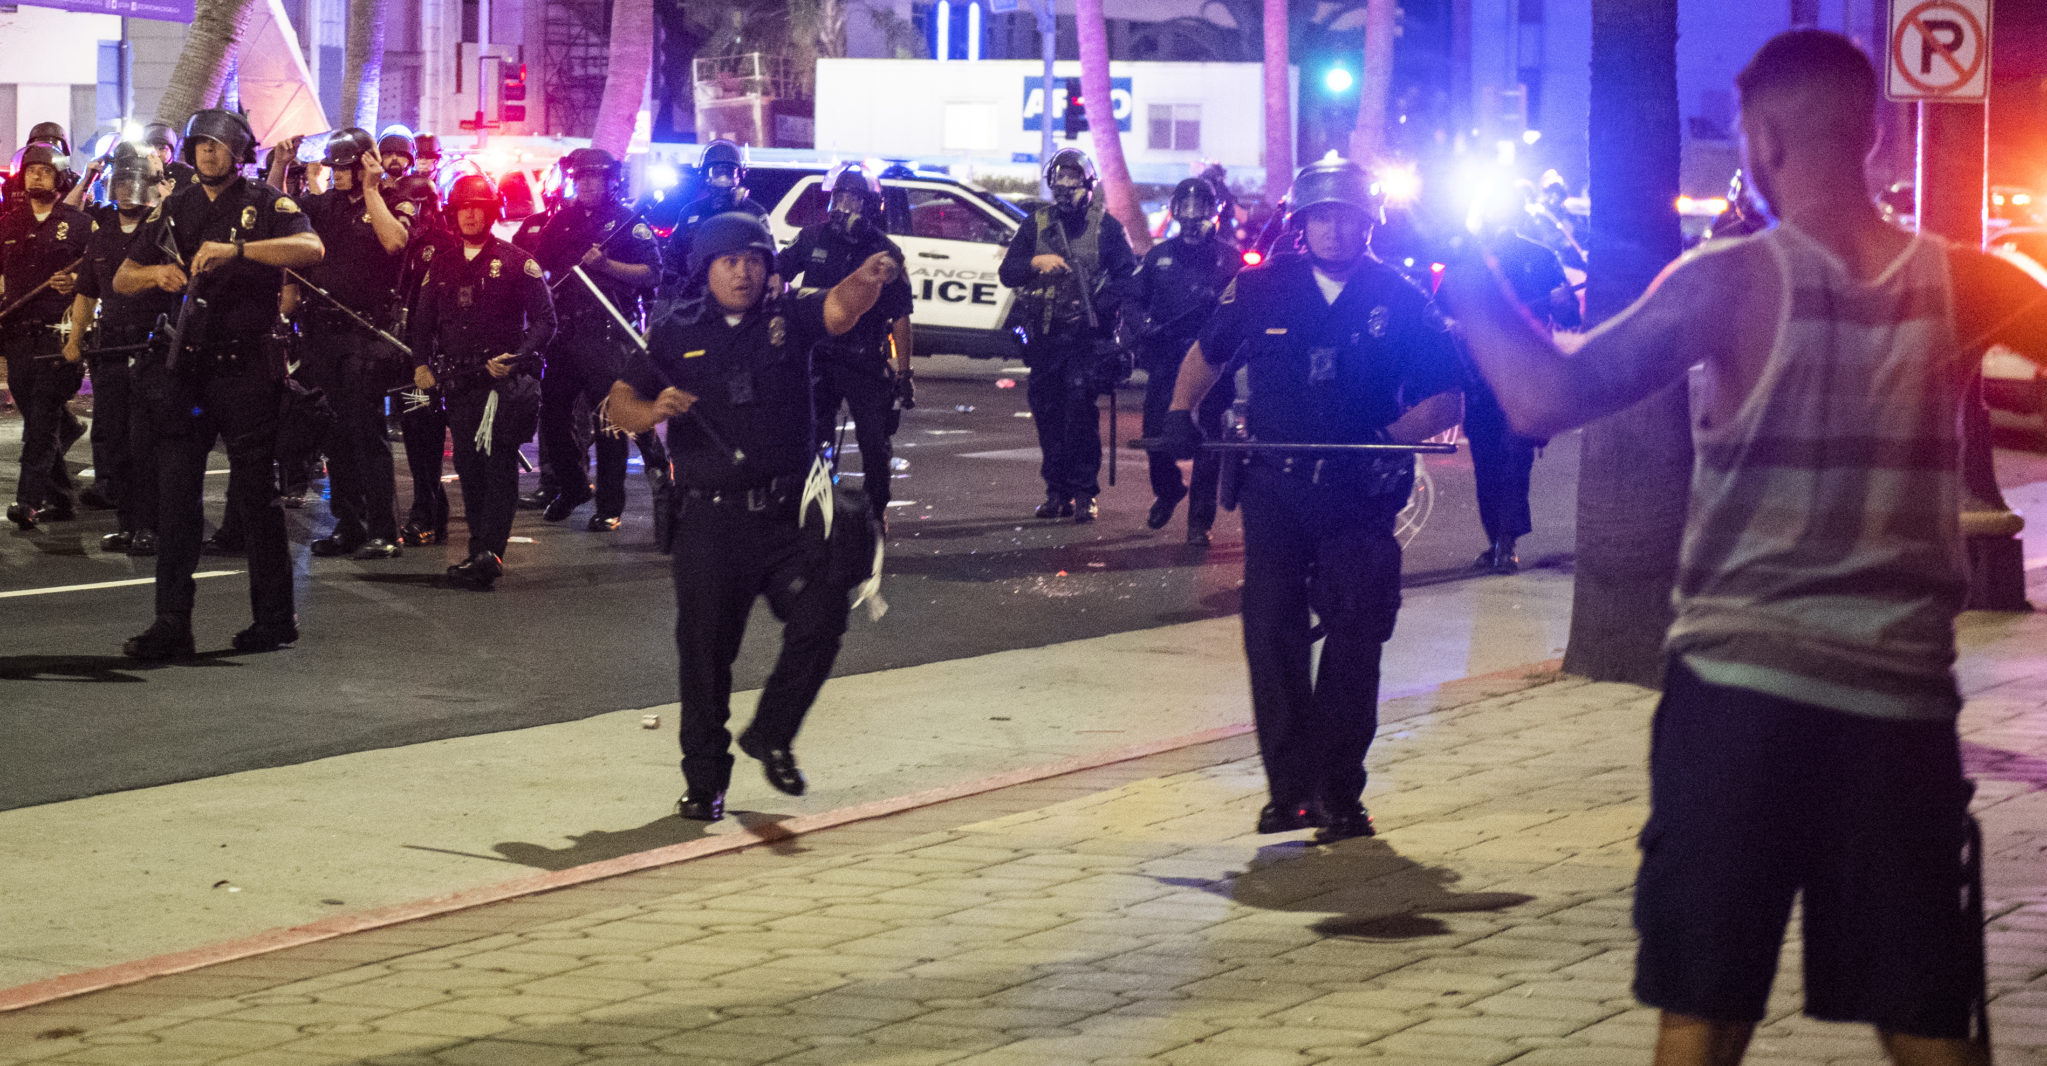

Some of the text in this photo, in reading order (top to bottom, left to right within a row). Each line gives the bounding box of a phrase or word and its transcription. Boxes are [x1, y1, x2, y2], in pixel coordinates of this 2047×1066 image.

[1921, 20, 1964, 74] P
[1023, 88, 1132, 119] AO
[913, 279, 998, 305] ICE
